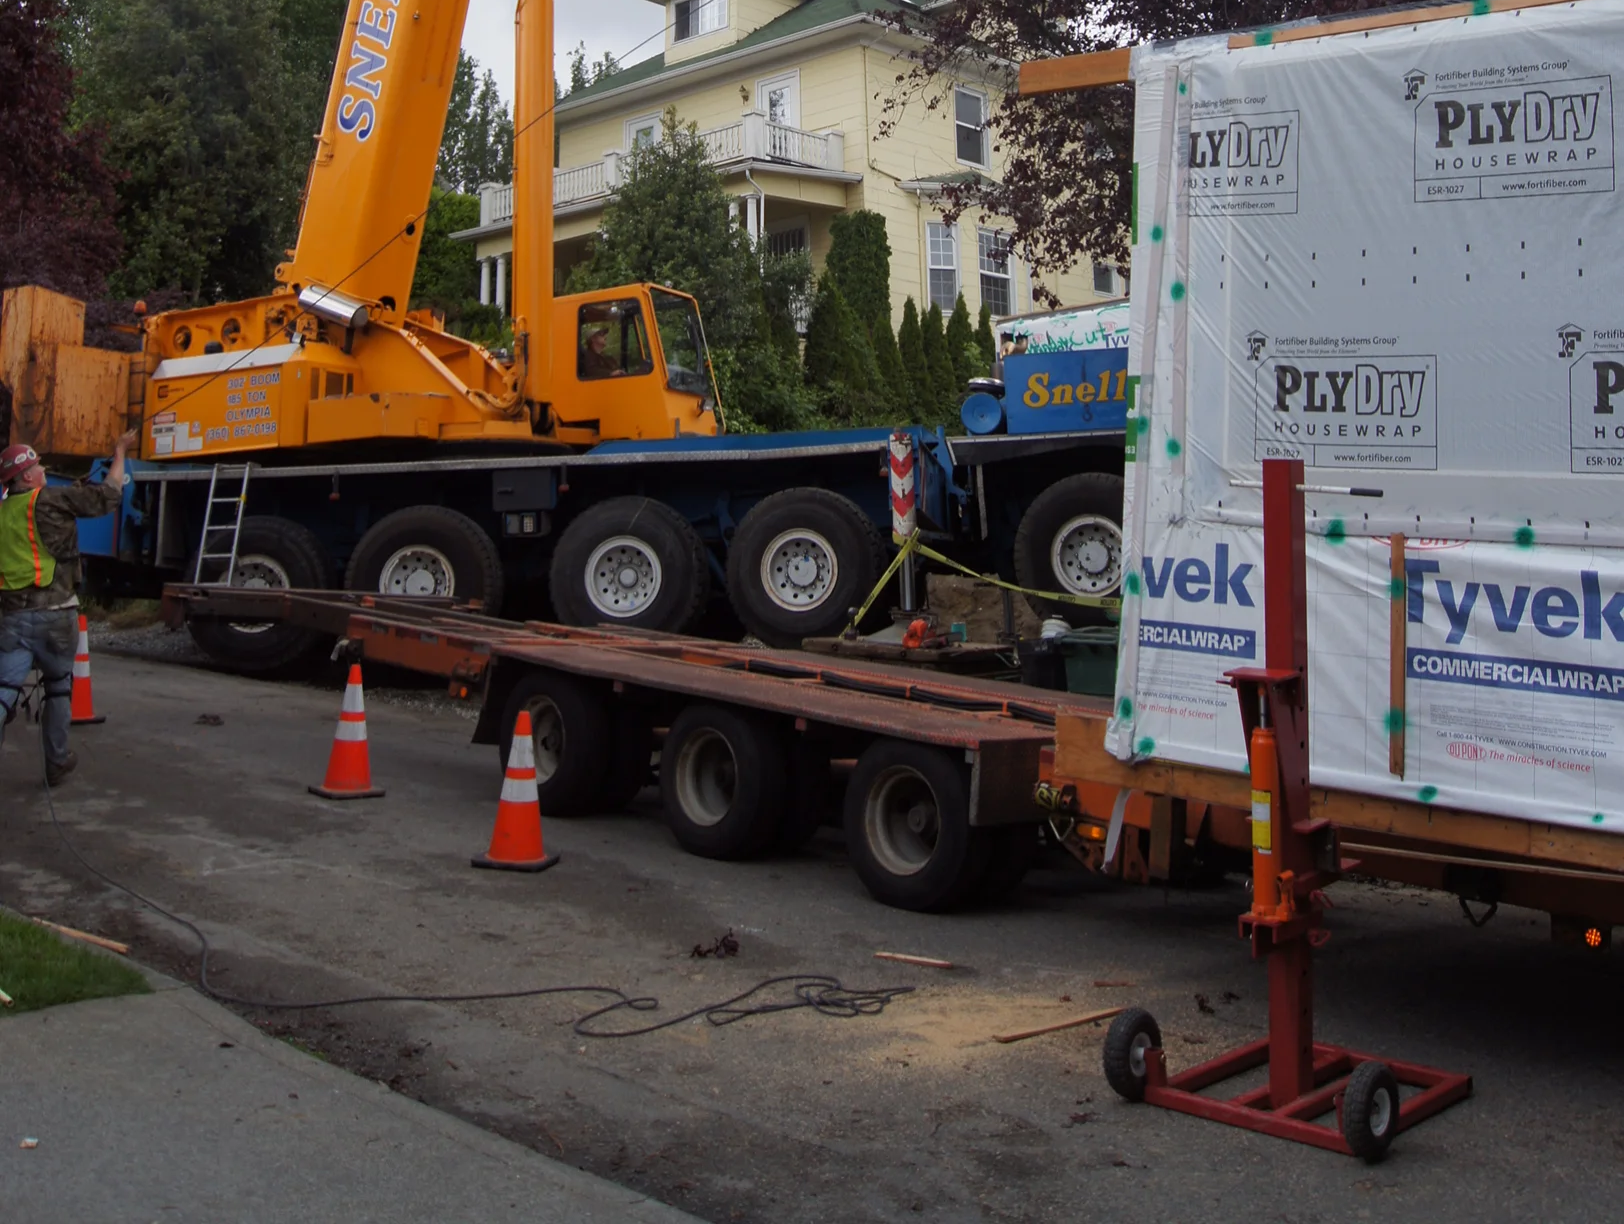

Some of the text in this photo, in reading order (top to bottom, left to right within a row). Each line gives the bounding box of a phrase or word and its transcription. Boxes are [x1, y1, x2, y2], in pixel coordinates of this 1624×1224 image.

[1435, 61, 1568, 82] Fortifiber Building Systems Group
[1244, 96, 1266, 105] Group
[1434, 90, 1600, 149] PLYDry
[1435, 147, 1597, 171] HOUSEWRAP
[1427, 185, 1465, 196] ESR-1027
[1502, 178, 1587, 191] www.fortifiber.com
[1275, 336, 1398, 347] Fortifiber Building Systems Group
[250, 372, 280, 386] BOOM
[248, 391, 266, 403] TON
[1023, 369, 1127, 408] Snell
[1273, 364, 1426, 418] PLYDry
[226, 406, 271, 422] OLYMPIA
[206, 427, 229, 442] (360)
[1275, 421, 1422, 438] HOUSEWRAP
[1266, 447, 1300, 459] ESR-1027
[1334, 453, 1412, 463] www.fortifiber.com
[1142, 543, 1256, 608] vek
[1389, 558, 1624, 645] Tyvek
[1412, 654, 1624, 694] COMMERCIALWRAP
[1149, 703, 1177, 715] miracles
[1179, 707, 1188, 718] of
[1189, 710, 1214, 720] science
[1489, 750, 1504, 761] The
[1506, 754, 1544, 766] miracles
[1546, 757, 1556, 769] of
[1557, 761, 1591, 773] science
